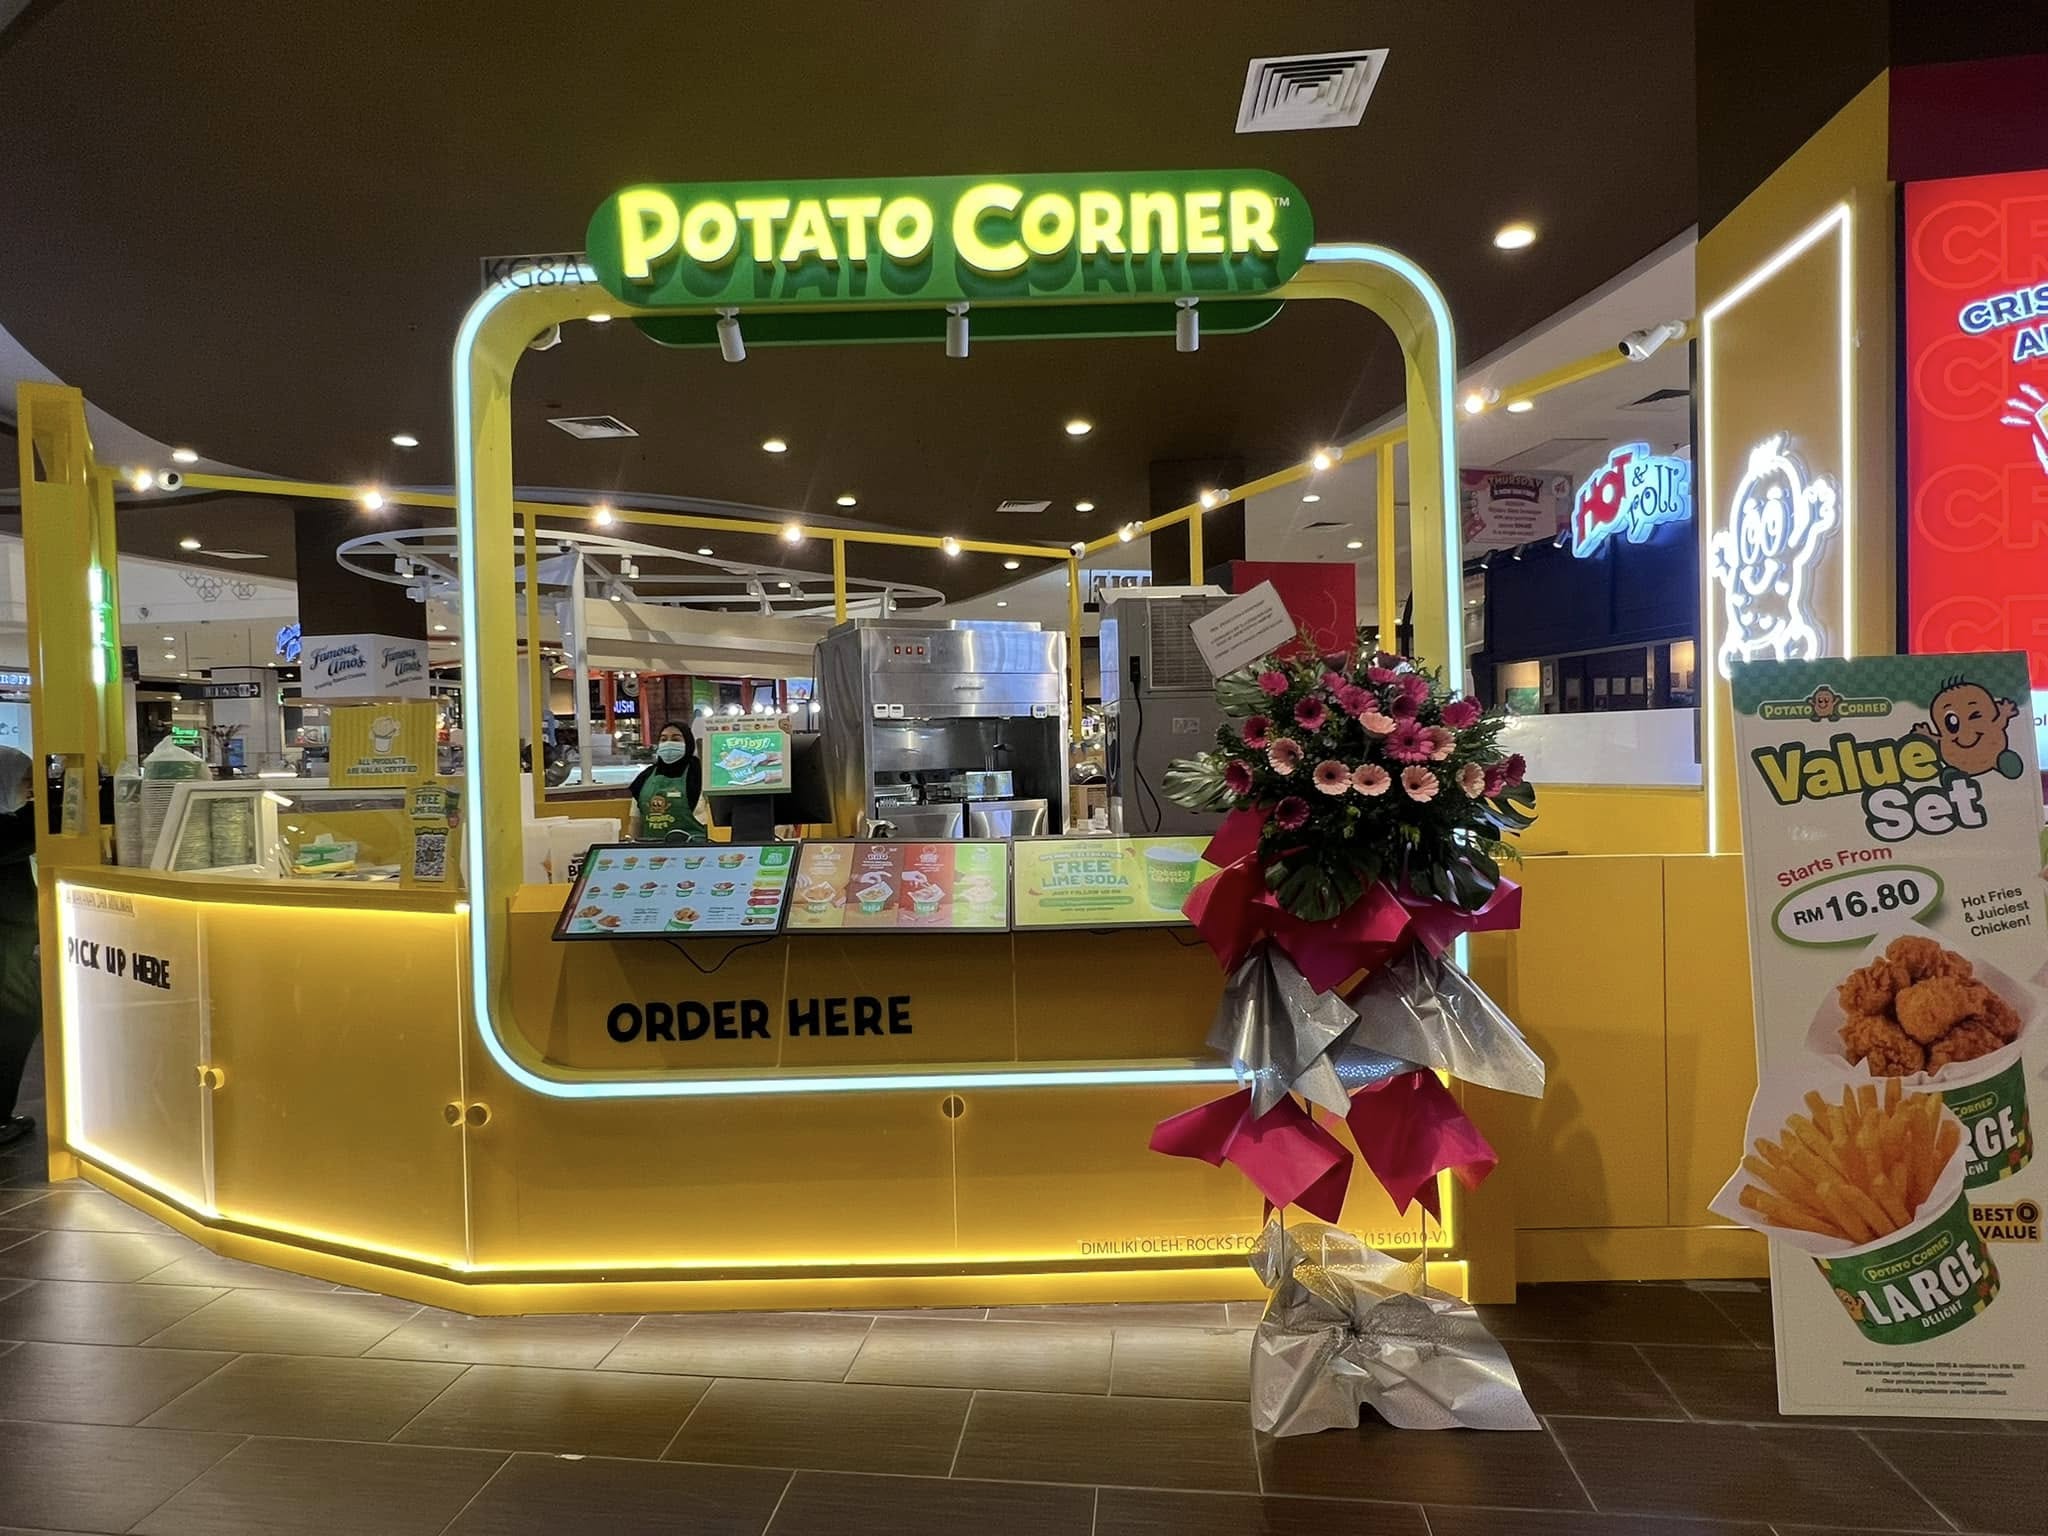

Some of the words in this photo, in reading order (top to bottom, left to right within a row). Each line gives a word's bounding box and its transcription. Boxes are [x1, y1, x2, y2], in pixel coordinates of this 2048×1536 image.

[618, 188, 934, 283] POTATO
[952, 183, 1280, 277] CORNER
[485, 254, 585, 288] KG8A
[2016, 326, 2048, 358] A
[1577, 452, 1633, 549] HOT
[1632, 464, 1648, 487] &
[310, 644, 359, 670] Famous
[328, 655, 367, 676] Amos
[1764, 704, 1812, 718] POTATO
[1837, 702, 1888, 715] CORNER
[726, 737, 770, 750] Enjoy!
[1755, 736, 1941, 803] Value
[1866, 776, 1986, 841] Set
[1053, 860, 1111, 874] FREE
[1777, 859, 1834, 888] Starts
[1836, 847, 1893, 867] From
[1042, 875, 1081, 888] LIME
[1084, 874, 1129, 886] SODA
[1826, 879, 1921, 922] 16.80
[1960, 894, 1987, 909] Hot
[1988, 887, 2023, 902] Fries
[1964, 912, 1975, 923] &
[1977, 900, 2030, 921] Juiciest
[1970, 914, 2032, 937] Chicken!
[68, 936, 100, 969] PICK
[105, 946, 126, 977] UP
[132, 952, 171, 989] HERE
[606, 999, 772, 1043] ORDER
[787, 996, 913, 1037] HERE
[1953, 1095, 1995, 1118] CORNER
[1972, 1207, 2015, 1222] BEST
[1081, 1239, 1138, 1255] DIMILIKI
[1141, 1238, 1184, 1253] OLEH:
[1186, 1236, 1233, 1251] ROCKS
[1977, 1225, 2038, 1240] VALUE
[1867, 1260, 1911, 1281] POTATO
[1912, 1236, 1950, 1266] CORNER
[1857, 1240, 1983, 1325] LARGE
[1921, 1300, 1963, 1328] DELIGHT
